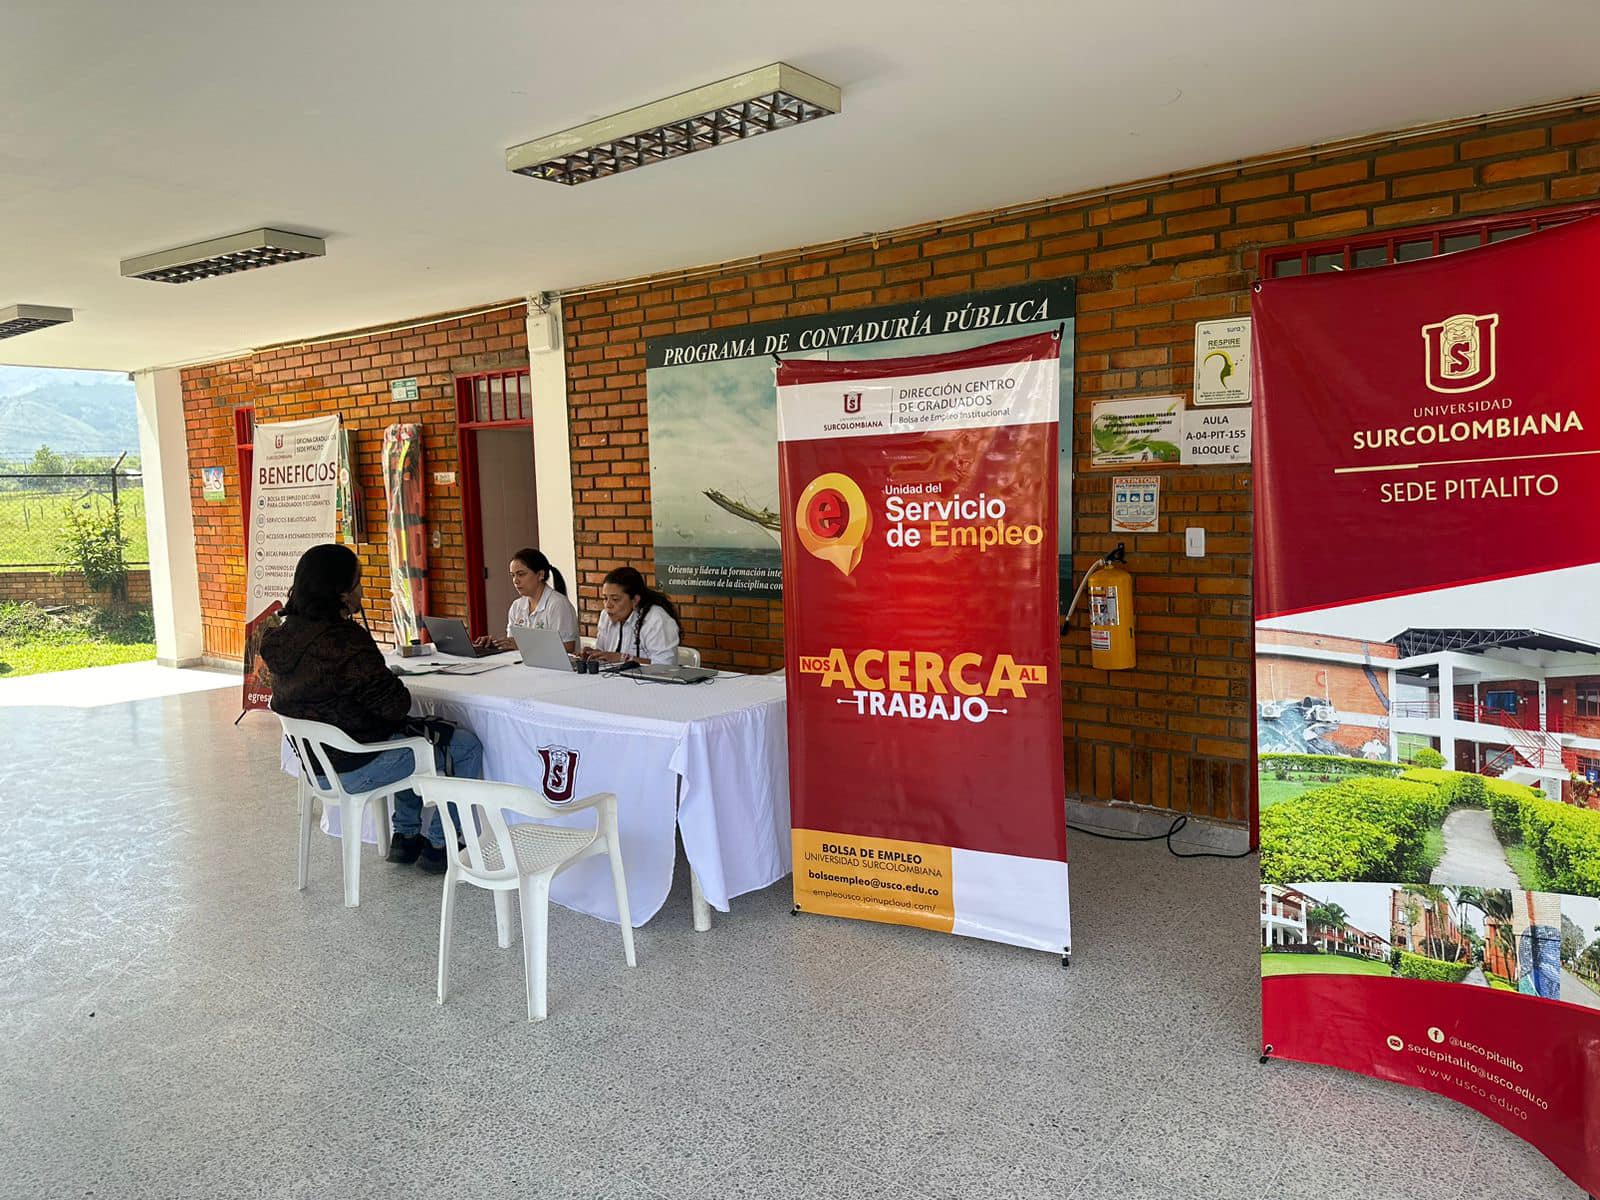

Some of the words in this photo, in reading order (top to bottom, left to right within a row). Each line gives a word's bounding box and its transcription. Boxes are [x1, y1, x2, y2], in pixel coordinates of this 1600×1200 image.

[663, 337, 755, 366] PROGRAMA
[763, 333, 790, 354] DE
[799, 310, 932, 350] CONTADURÍA
[943, 297, 1049, 332] PÚBLICA
[1208, 338, 1241, 347] RESPIRE
[899, 382, 962, 400] DIRECCIÓN
[965, 378, 1015, 392] CENTRO
[899, 402, 914, 412] DE
[917, 394, 993, 412] GRADUADOS
[1413, 398, 1513, 418] UNIVERSIDAD
[823, 421, 883, 432] SURCOLOMBIANA
[898, 415, 919, 424] Bolsa
[919, 414, 930, 422] de
[959, 408, 1010, 420] Institucional
[1203, 415, 1229, 425] AULA
[1186, 430, 1246, 441] A-04-PIT-155
[1353, 410, 1584, 449] SURCOLOMBIANA
[1192, 444, 1230, 455] BLOQUE
[1233, 444, 1240, 453] C
[259, 462, 336, 485] BENEFICIOS
[885, 484, 923, 495] Unidad
[925, 483, 942, 494] del
[1380, 481, 1437, 503] SEDE
[1445, 474, 1559, 500] PITALITO
[885, 493, 1006, 522] Servicio
[886, 522, 921, 547] de
[930, 520, 1044, 552] Empleo
[668, 564, 694, 574] Orienta
[693, 567, 700, 577] y
[699, 565, 720, 575] lidera
[720, 566, 728, 576] la
[727, 566, 766, 578] formación
[767, 569, 783, 579] inte
[668, 577, 716, 587] conocimientos
[716, 578, 725, 588] de
[726, 578, 733, 588] la
[734, 579, 769, 591] disciplina
[801, 658, 831, 672] NOS
[820, 648, 1027, 699] ACERCA
[1019, 667, 1040, 682] AL
[247, 692, 272, 704] egresa
[852, 690, 989, 723] TRABAJO
[804, 852, 860, 867] UNIVERSIDAD
[862, 859, 943, 878] SURCOLOMBIANA
[822, 843, 857, 857] BOLSA
[860, 849, 875, 859] DE
[877, 850, 922, 865] EMPLEO
[808, 869, 939, 896] bolsaempleo@usco.edu.co
[812, 889, 937, 913] empleousco.joinupcloud.com/
[1407, 1043, 1549, 1110] sedepitalito@usco.edu.co
